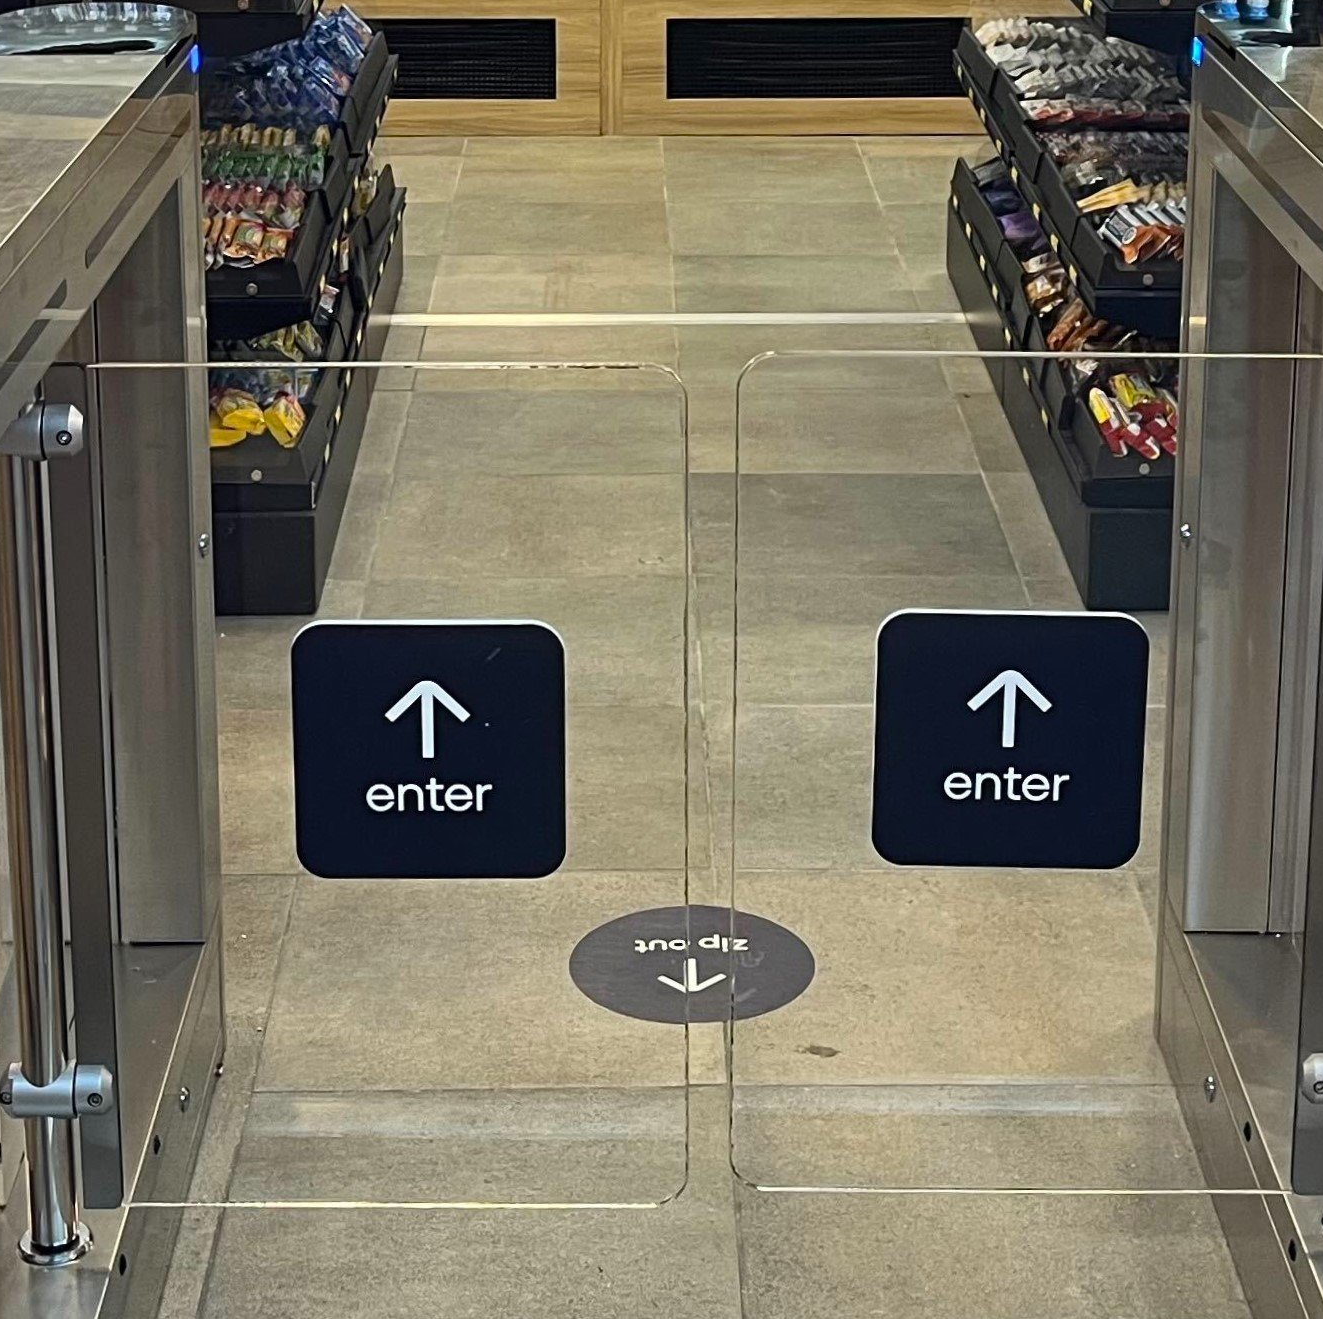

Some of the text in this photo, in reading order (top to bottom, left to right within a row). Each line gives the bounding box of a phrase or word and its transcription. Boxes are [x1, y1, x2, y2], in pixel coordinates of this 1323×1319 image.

[365, 777, 493, 814] enter
[942, 766, 1070, 804] enter
[634, 934, 749, 953] zip out
